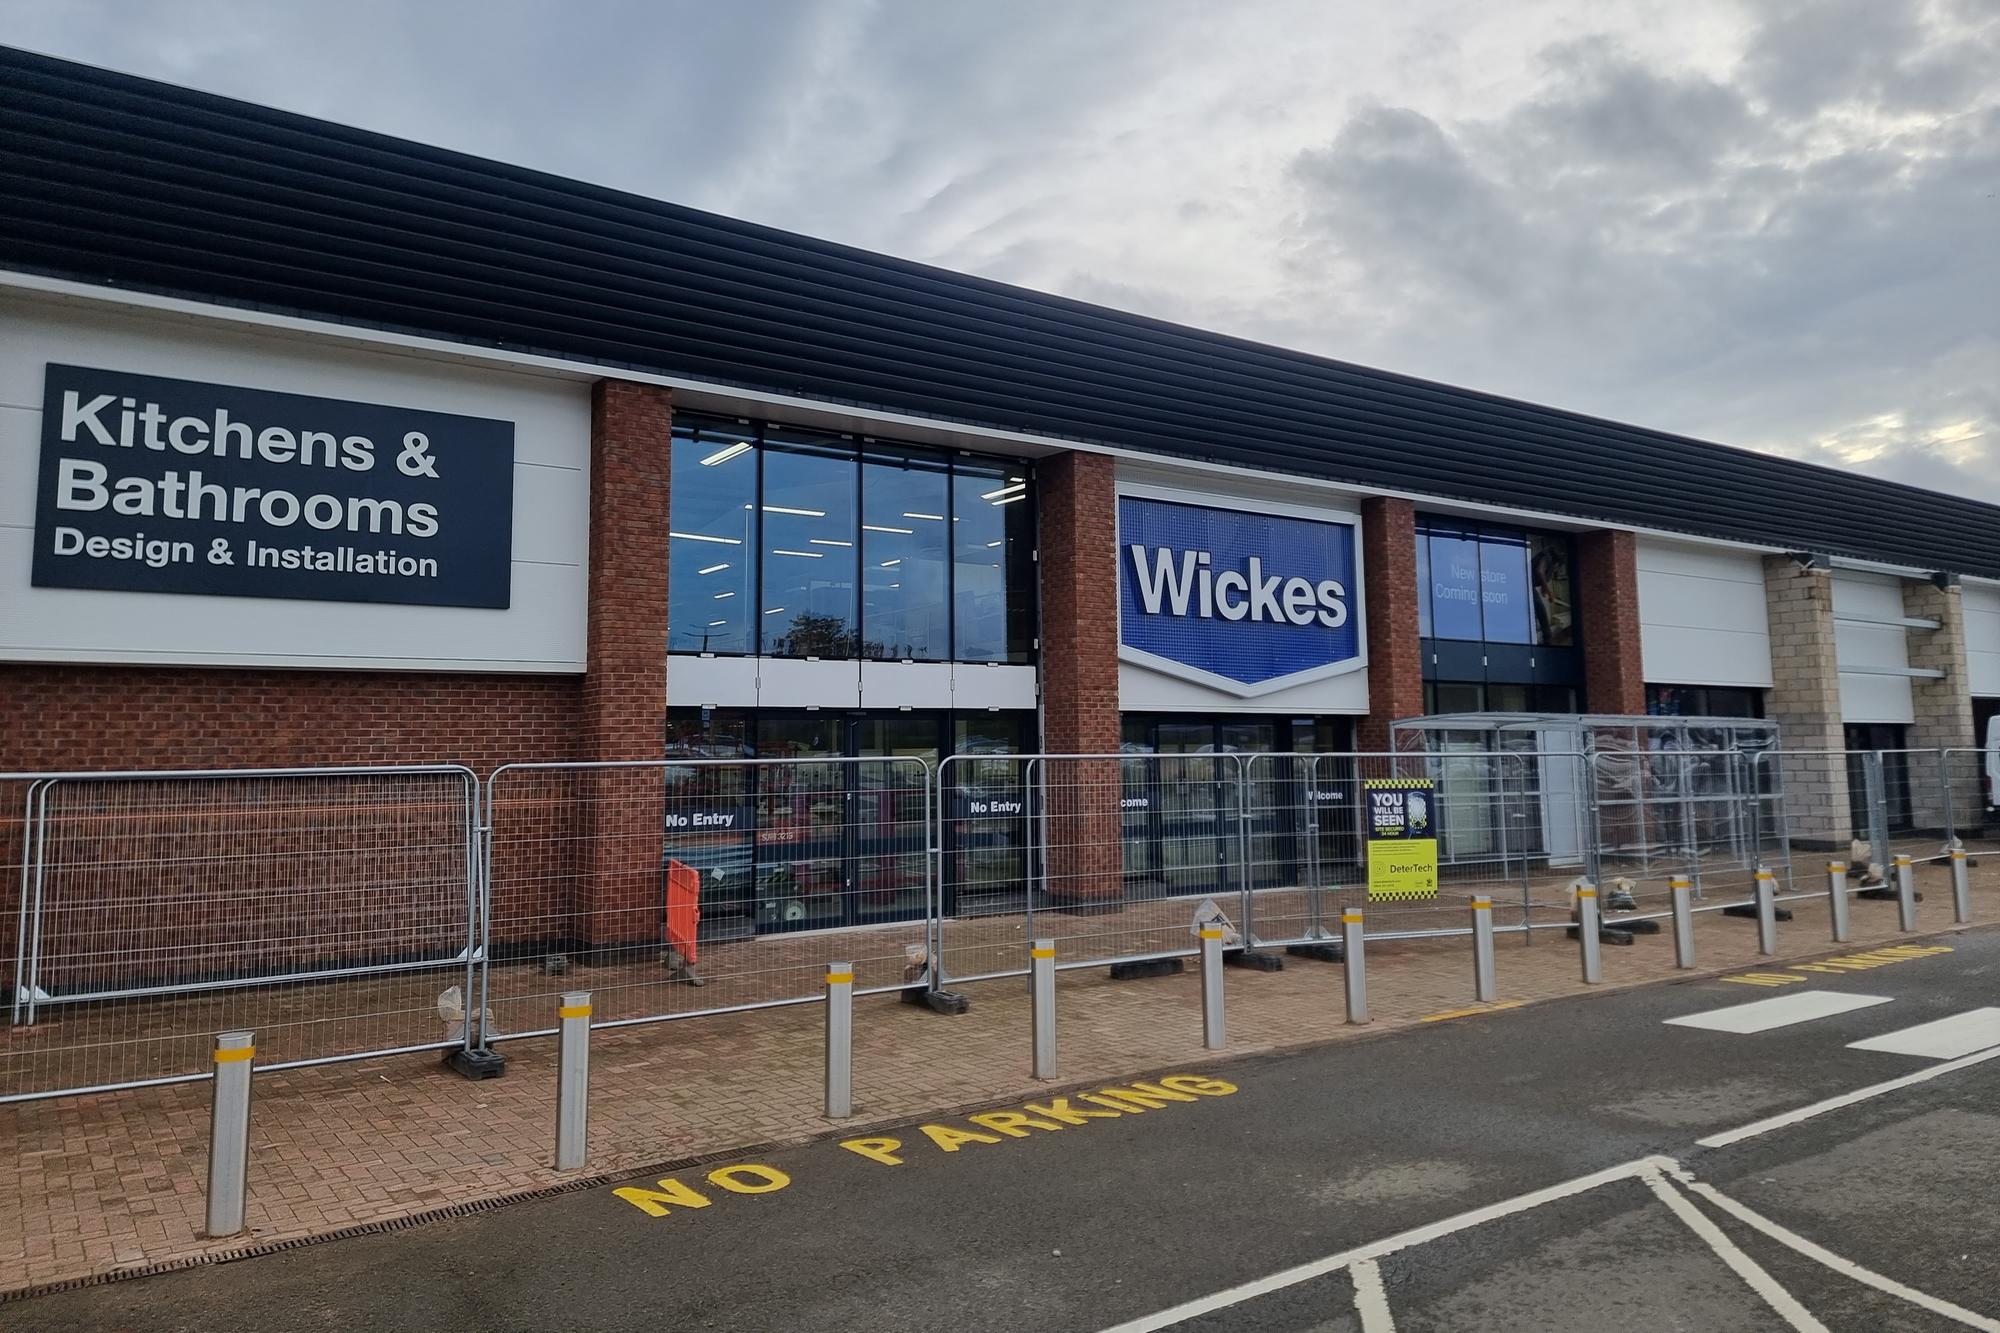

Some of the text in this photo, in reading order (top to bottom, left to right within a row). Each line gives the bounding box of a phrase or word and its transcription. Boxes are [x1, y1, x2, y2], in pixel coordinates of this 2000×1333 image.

[61, 390, 440, 479] Kitchens &
[57, 458, 440, 538] Bathrooms
[53, 527, 439, 578] Design & Installation
[1451, 564, 1507, 584] New store
[1131, 544, 1347, 628] Wickes
[1435, 583, 1508, 605] Coming soon
[970, 800, 1022, 814] No Entry
[1120, 798, 1149, 807] come
[1373, 793, 1403, 806] YOU
[665, 812, 734, 828] No Entry
[1375, 815, 1404, 826] SEEN
[1390, 863, 1433, 873] DeterTech
[611, 1075, 1239, 1217] NO PARKING
